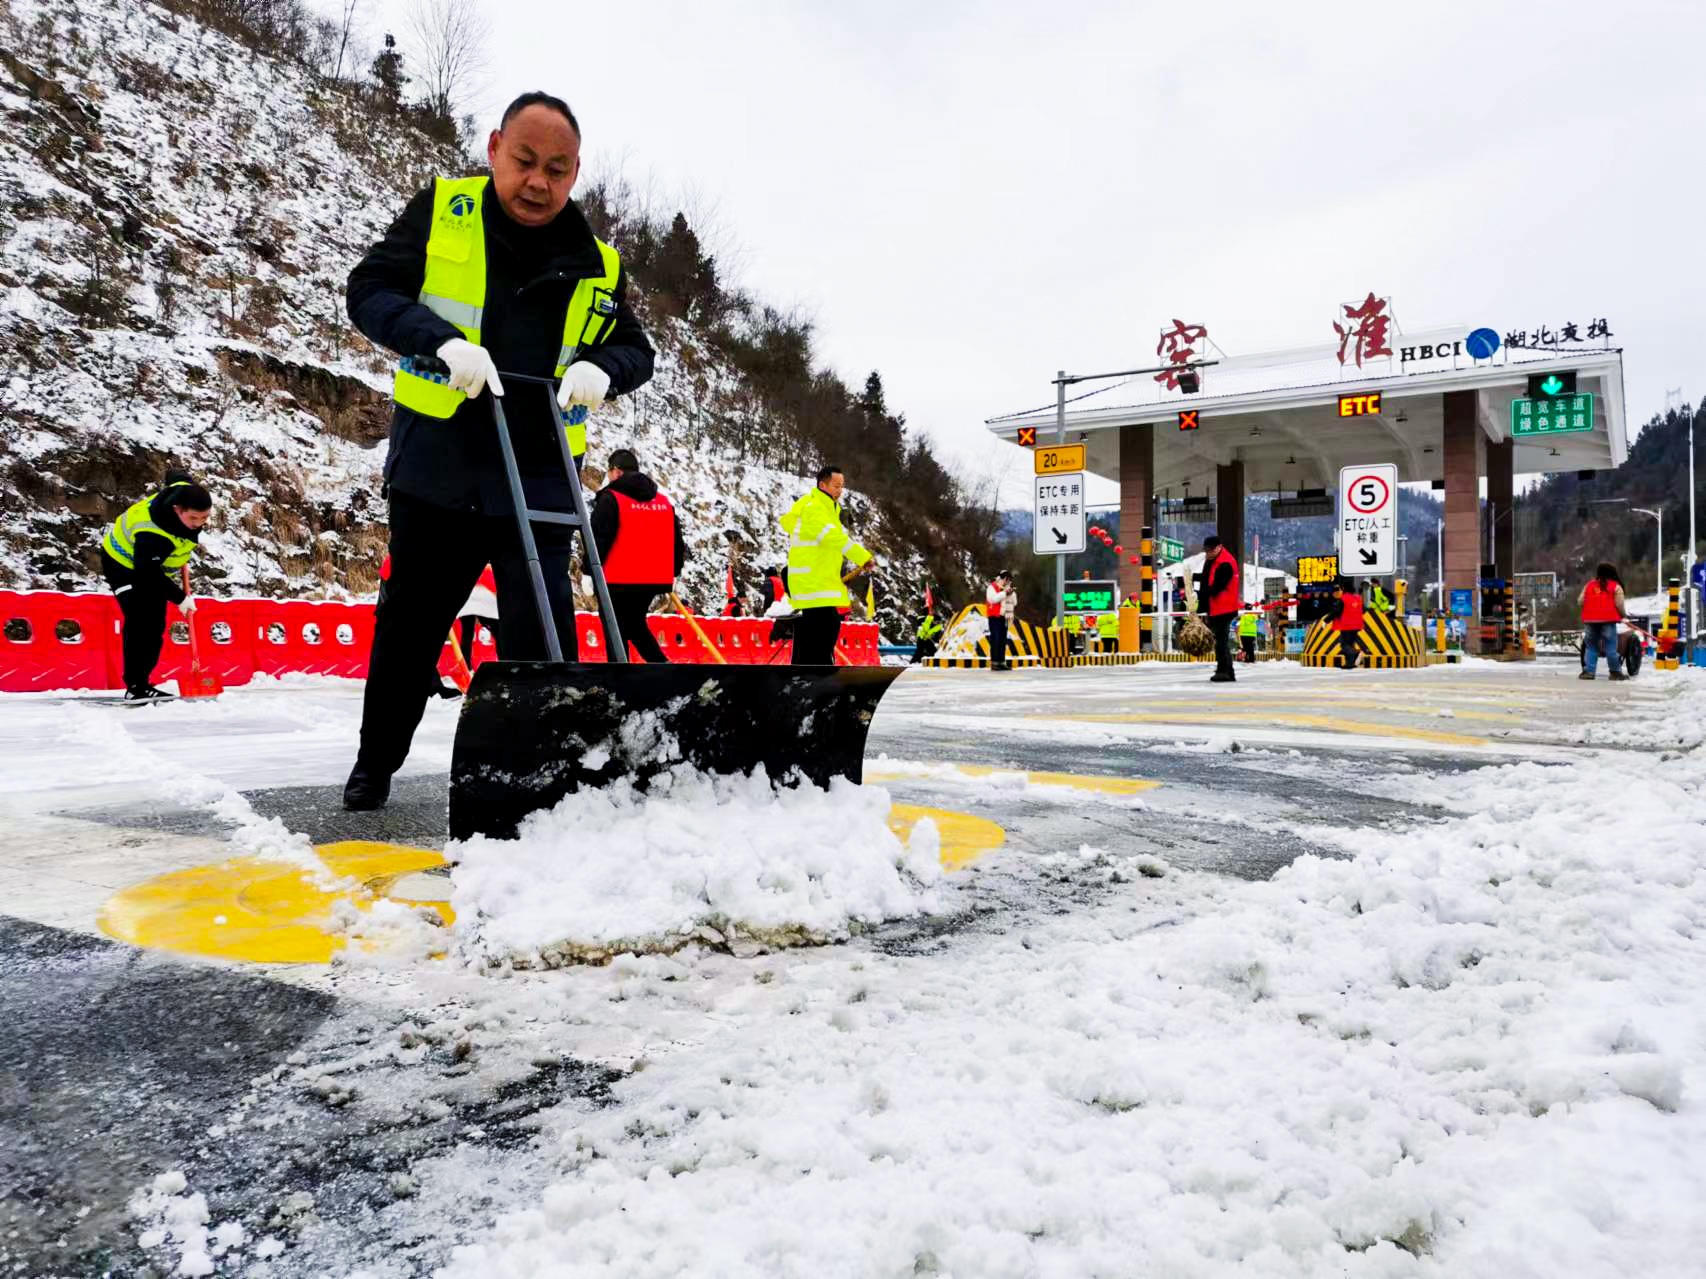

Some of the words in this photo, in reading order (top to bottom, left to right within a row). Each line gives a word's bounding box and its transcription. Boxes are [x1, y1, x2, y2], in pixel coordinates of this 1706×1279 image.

[1506, 318, 1614, 348] 湖北交投
[1400, 341, 1461, 362] HBCI
[1340, 395, 1380, 417] ETC
[1520, 397, 1584, 416] 超宽车道
[1520, 414, 1584, 432] 绿色通道
[1044, 453, 1058, 468] 20
[1039, 484, 1080, 499] ETC专用
[1361, 484, 1376, 506] 5
[1040, 503, 1079, 517] 保持车距
[1344, 517, 1391, 531] ETC/人工
[1357, 531, 1379, 544] 称重
